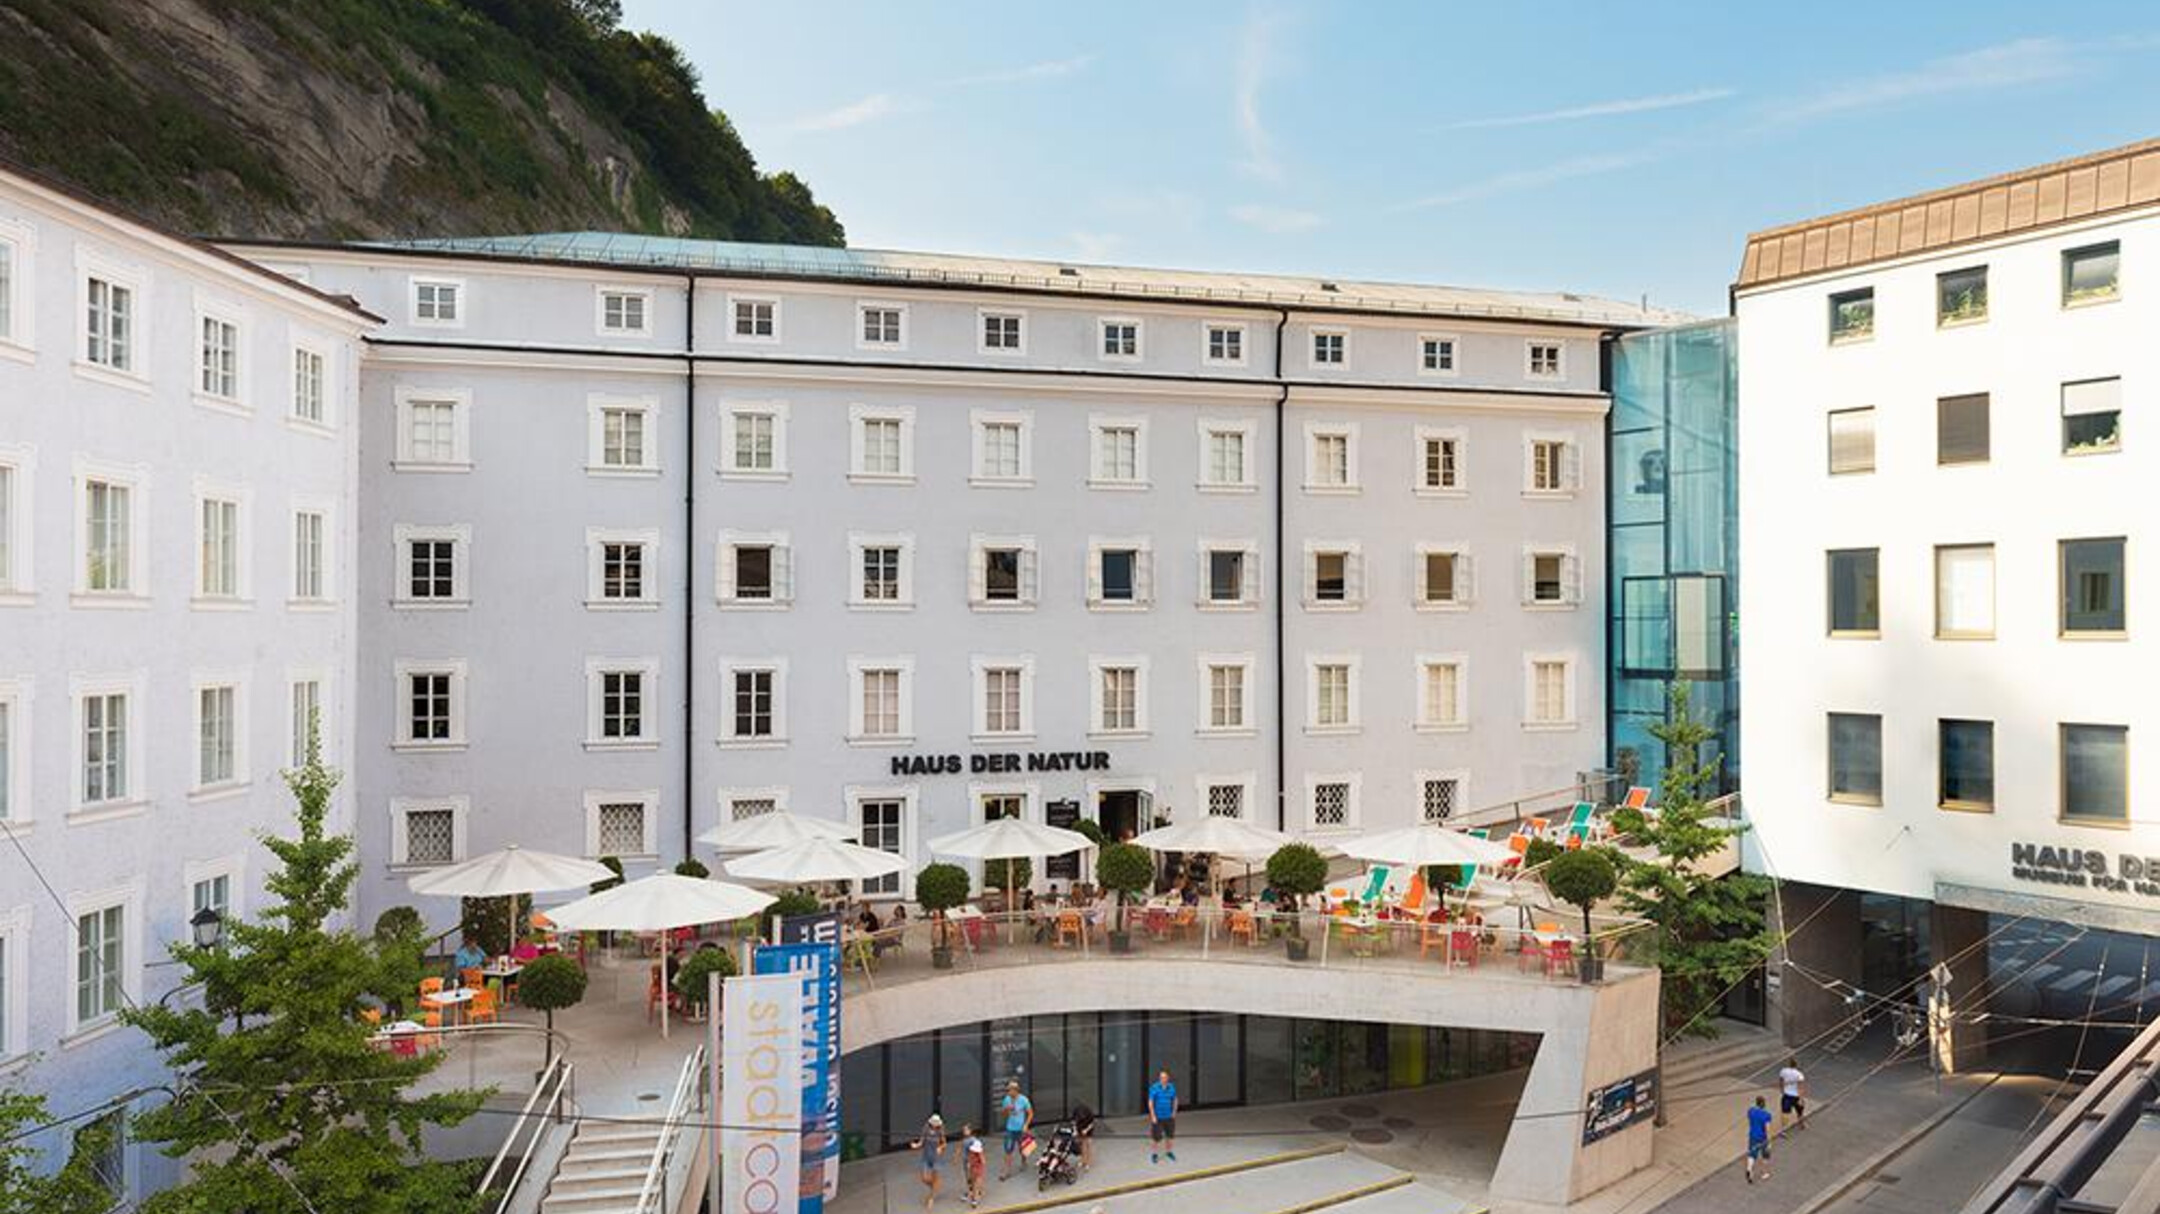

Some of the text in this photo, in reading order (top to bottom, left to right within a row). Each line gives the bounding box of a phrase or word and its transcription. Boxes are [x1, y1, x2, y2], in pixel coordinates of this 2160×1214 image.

[891, 751, 1110, 775] HAUS DER NATUR
[2013, 843, 2106, 874] HAUS
